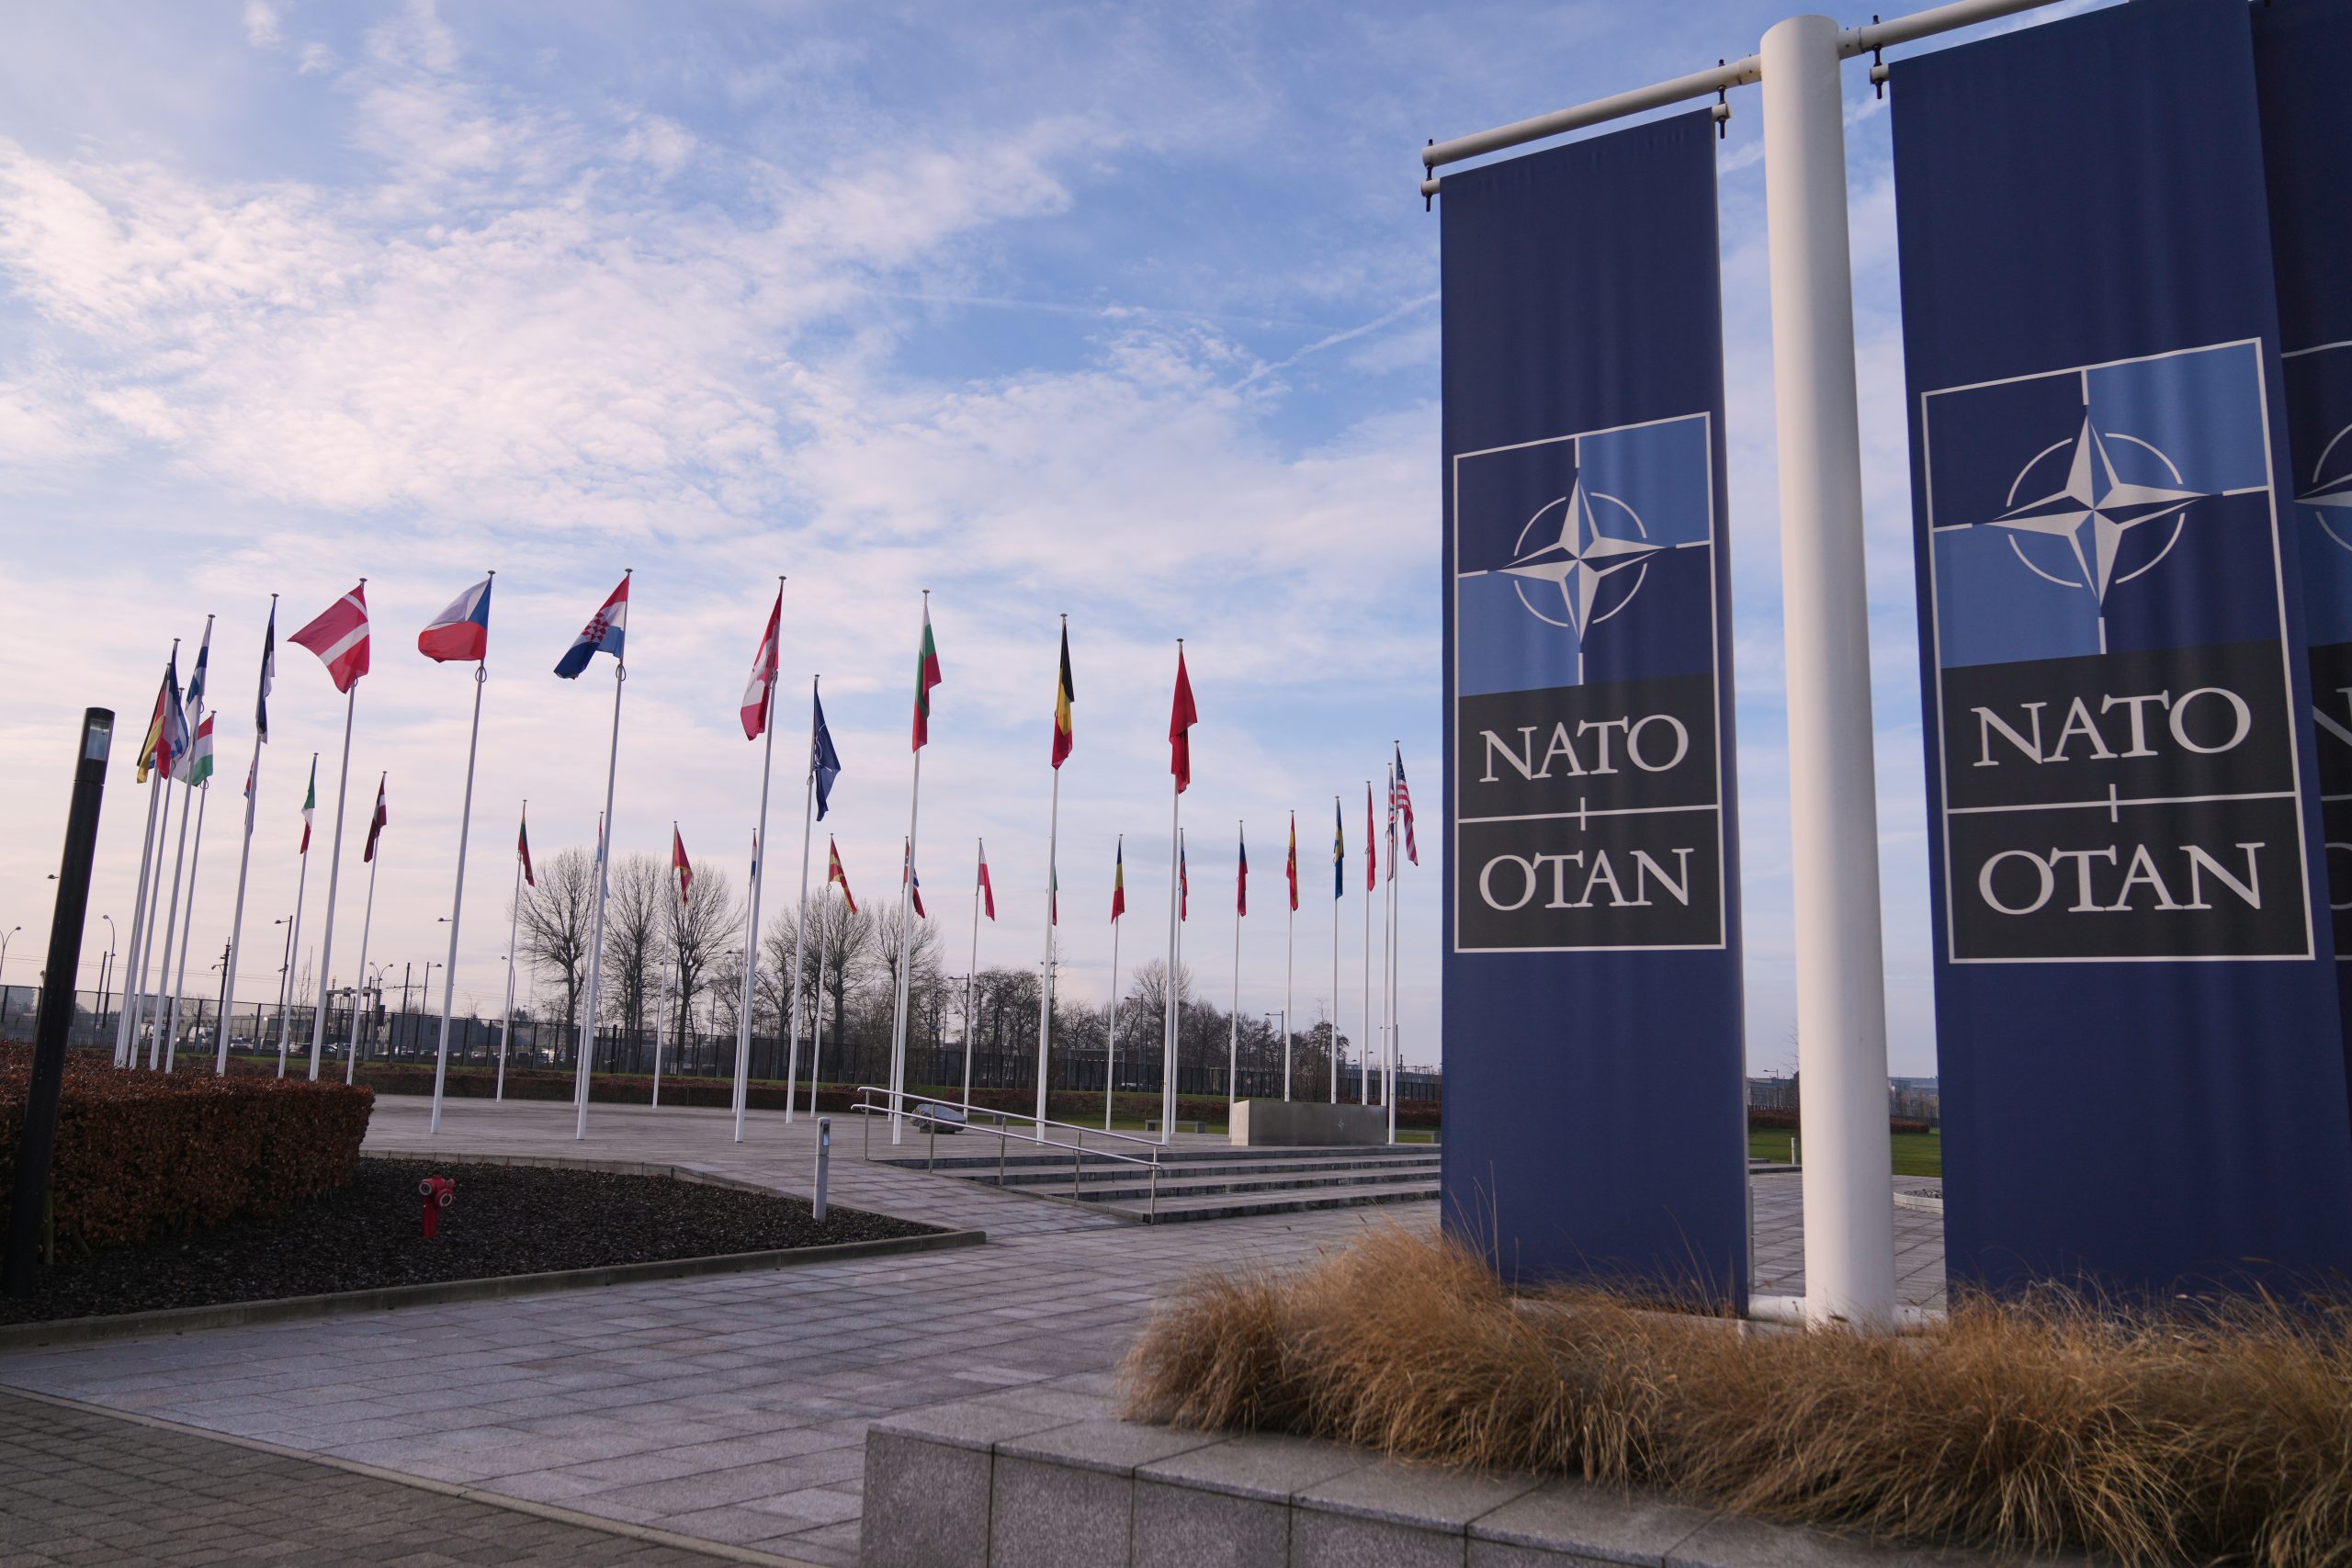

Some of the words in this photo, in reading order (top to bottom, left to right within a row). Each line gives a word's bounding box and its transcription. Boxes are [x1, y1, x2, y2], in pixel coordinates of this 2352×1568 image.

[1479, 714, 1689, 782] NATO
[1970, 687, 2252, 767] NATO
[1479, 848, 1694, 910] OTAN
[1979, 841, 2266, 915] OTAN
